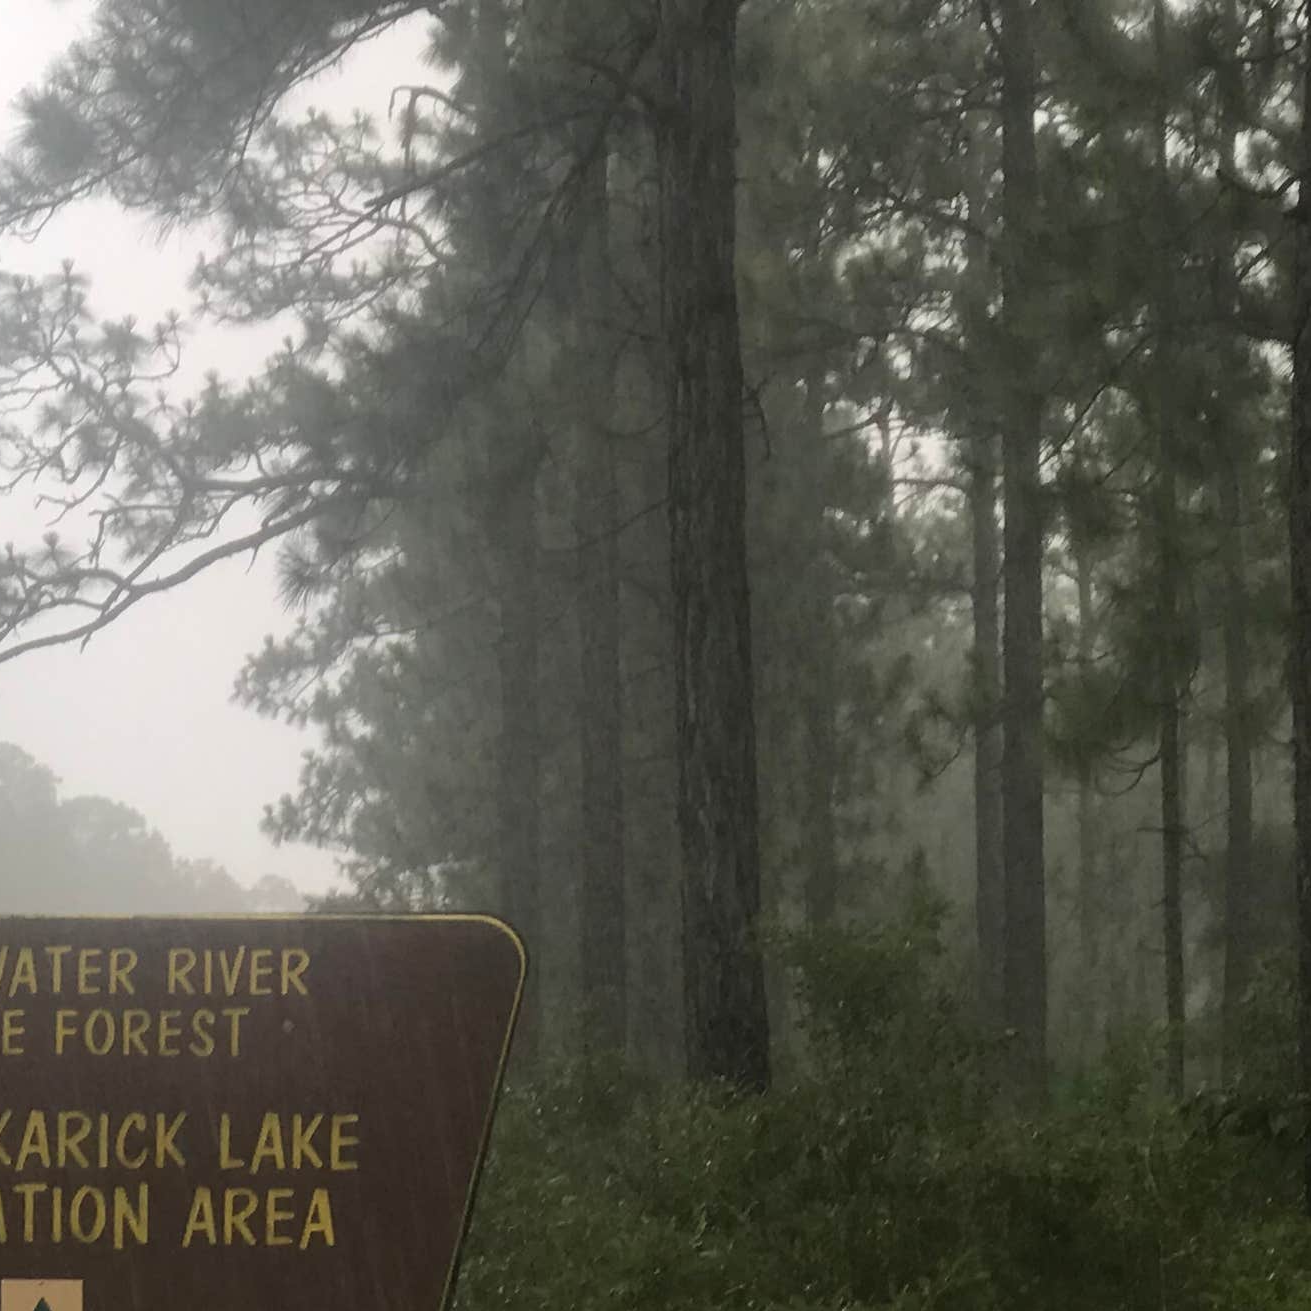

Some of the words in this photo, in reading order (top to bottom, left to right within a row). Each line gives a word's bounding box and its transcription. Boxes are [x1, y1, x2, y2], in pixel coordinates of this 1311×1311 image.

[167, 948, 312, 995] RIVER
[54, 1007, 249, 1057] FOREST
[219, 1112, 361, 1172] LAKE
[181, 1186, 337, 1250] AREA
